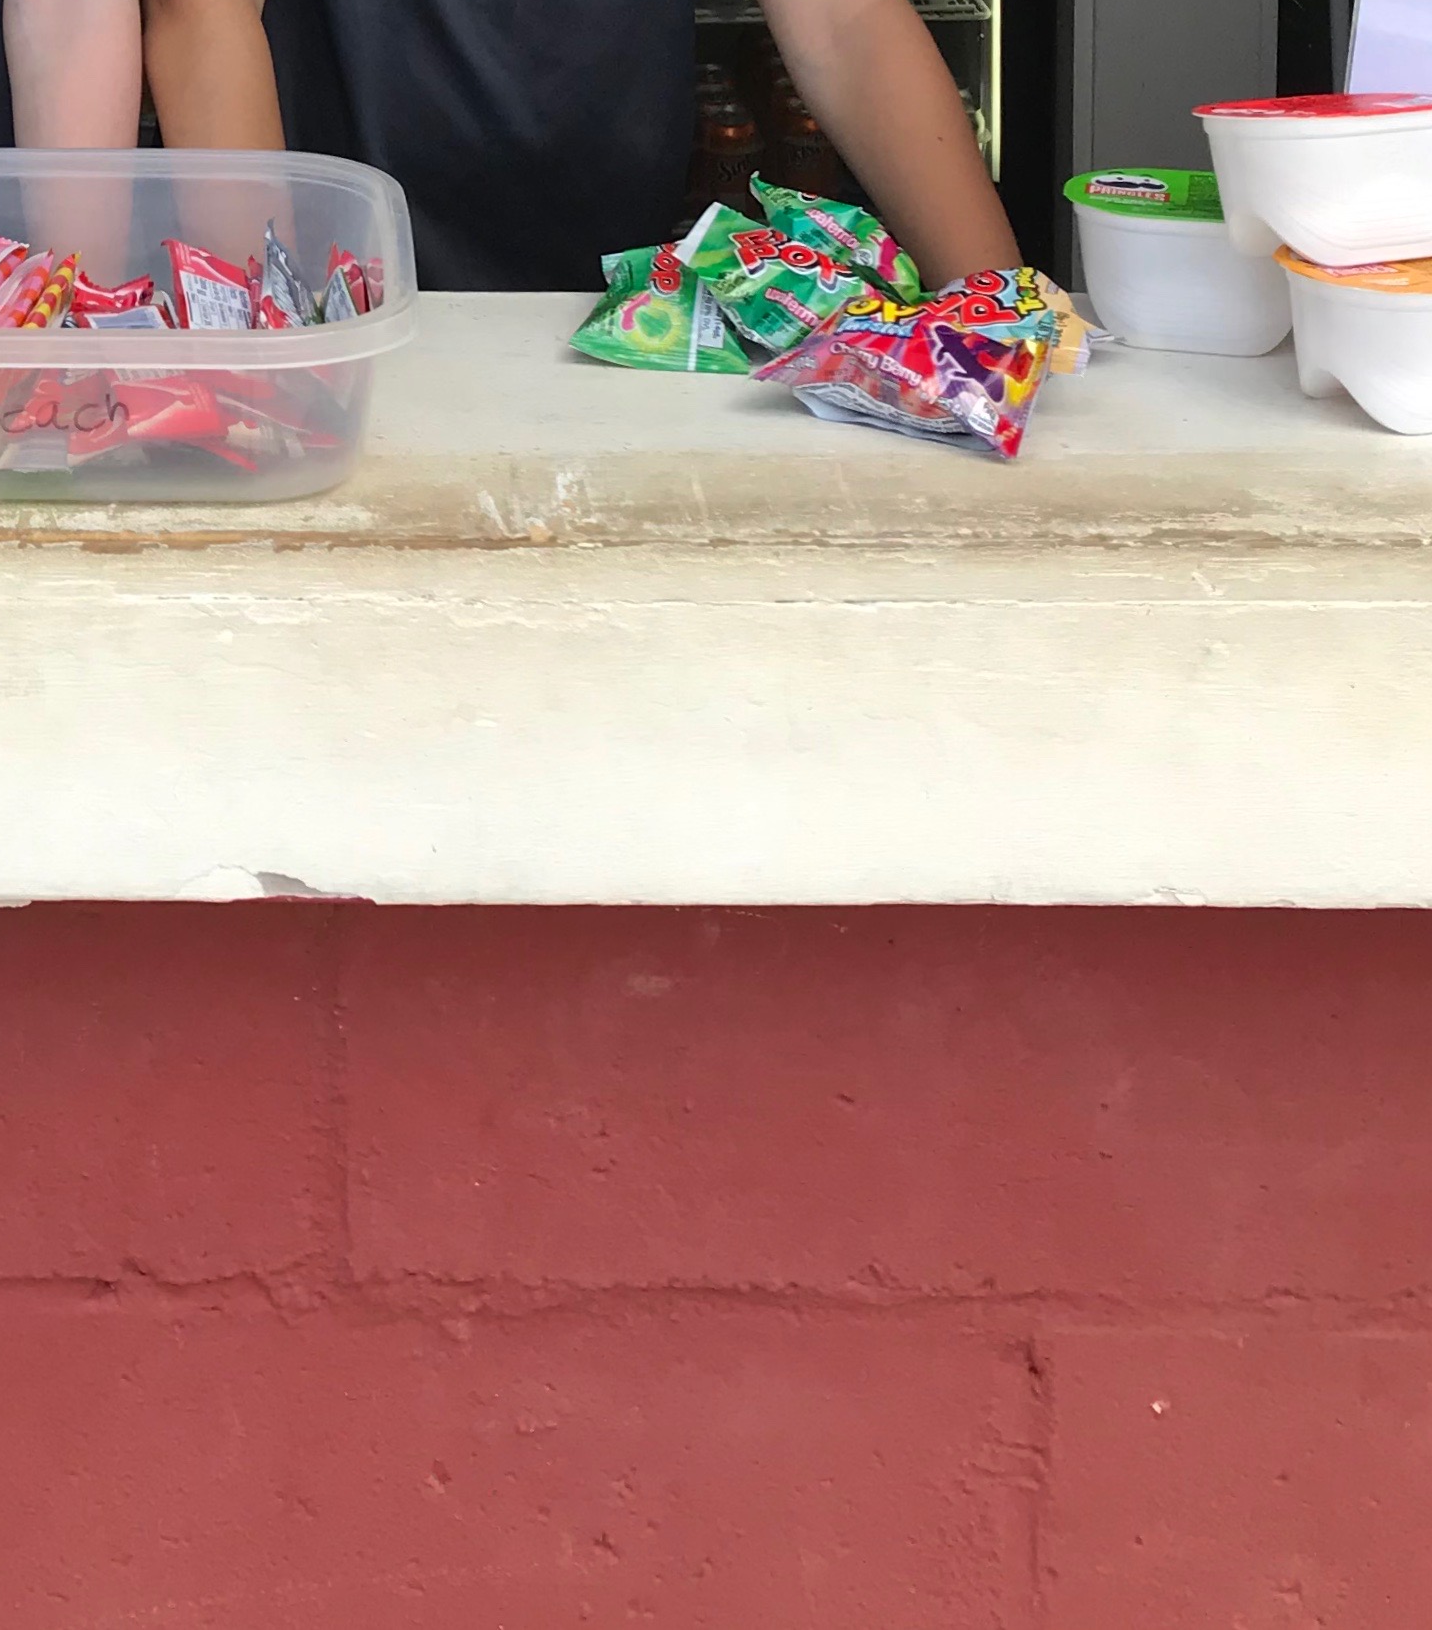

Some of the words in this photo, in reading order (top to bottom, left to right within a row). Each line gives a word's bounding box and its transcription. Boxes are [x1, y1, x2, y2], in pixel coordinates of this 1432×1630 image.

[829, 341, 879, 370] Cherry
[880, 354, 924, 387] Berry
[0, 393, 130, 433] each
